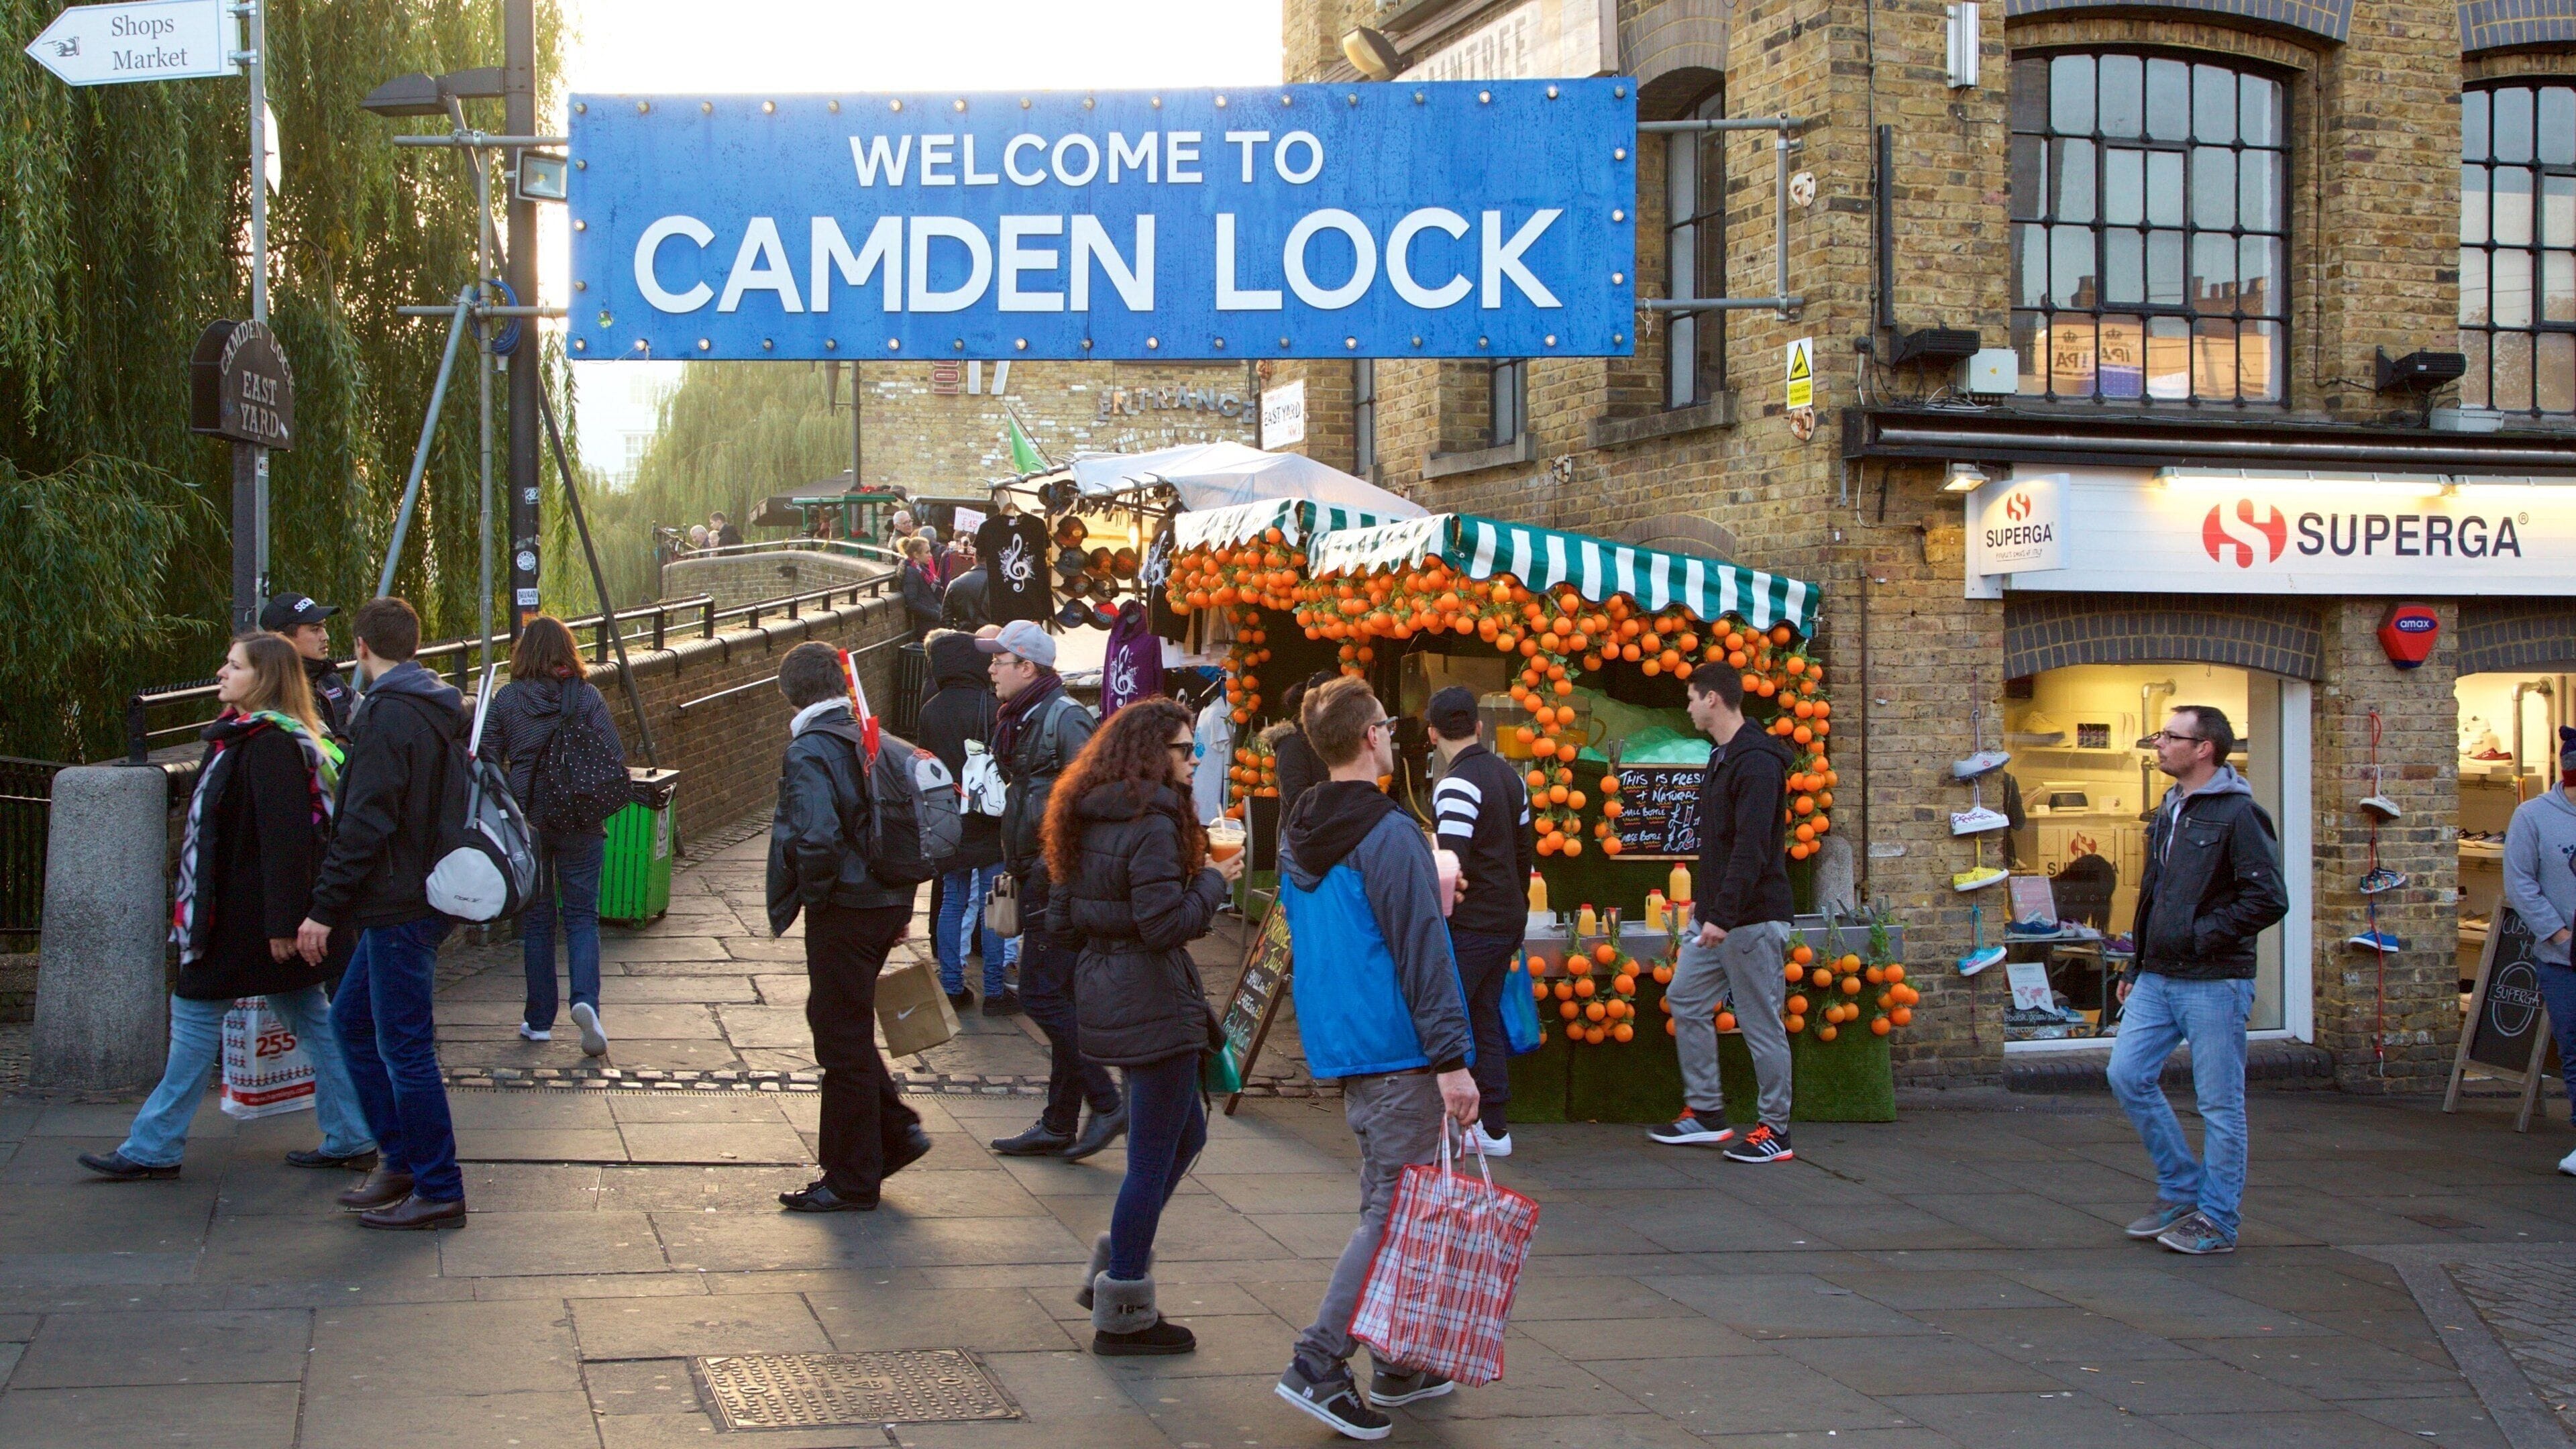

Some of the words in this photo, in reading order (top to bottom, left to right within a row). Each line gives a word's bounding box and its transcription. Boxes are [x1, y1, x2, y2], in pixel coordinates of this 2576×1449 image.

[111, 15, 174, 40] Shops
[112, 46, 189, 70] Market
[849, 131, 1203, 187] WELCOME
[1225, 129, 1324, 184] TO
[633, 214, 1156, 313] CAMDEN
[1216, 207, 1564, 310] LOCK
[221, 320, 262, 376] CAMDEN
[270, 333, 295, 396] LOCK
[241, 370, 277, 406] EAST
[1097, 386, 1256, 425] ENTRANCE
[1265, 406, 1281, 427] EAST
[1282, 401, 1301, 422] YARD
[240, 402, 279, 438] YARD
[1986, 523, 2053, 547] SUPERGA
[2296, 511, 2522, 558] SUPERGA
[2400, 620, 2430, 628] amax
[1652, 786, 1700, 802] NATURAL
[1621, 833, 1638, 843] ARGE
[2494, 985, 2540, 1006] SUPERGA
[255, 1032, 297, 1057] 255
